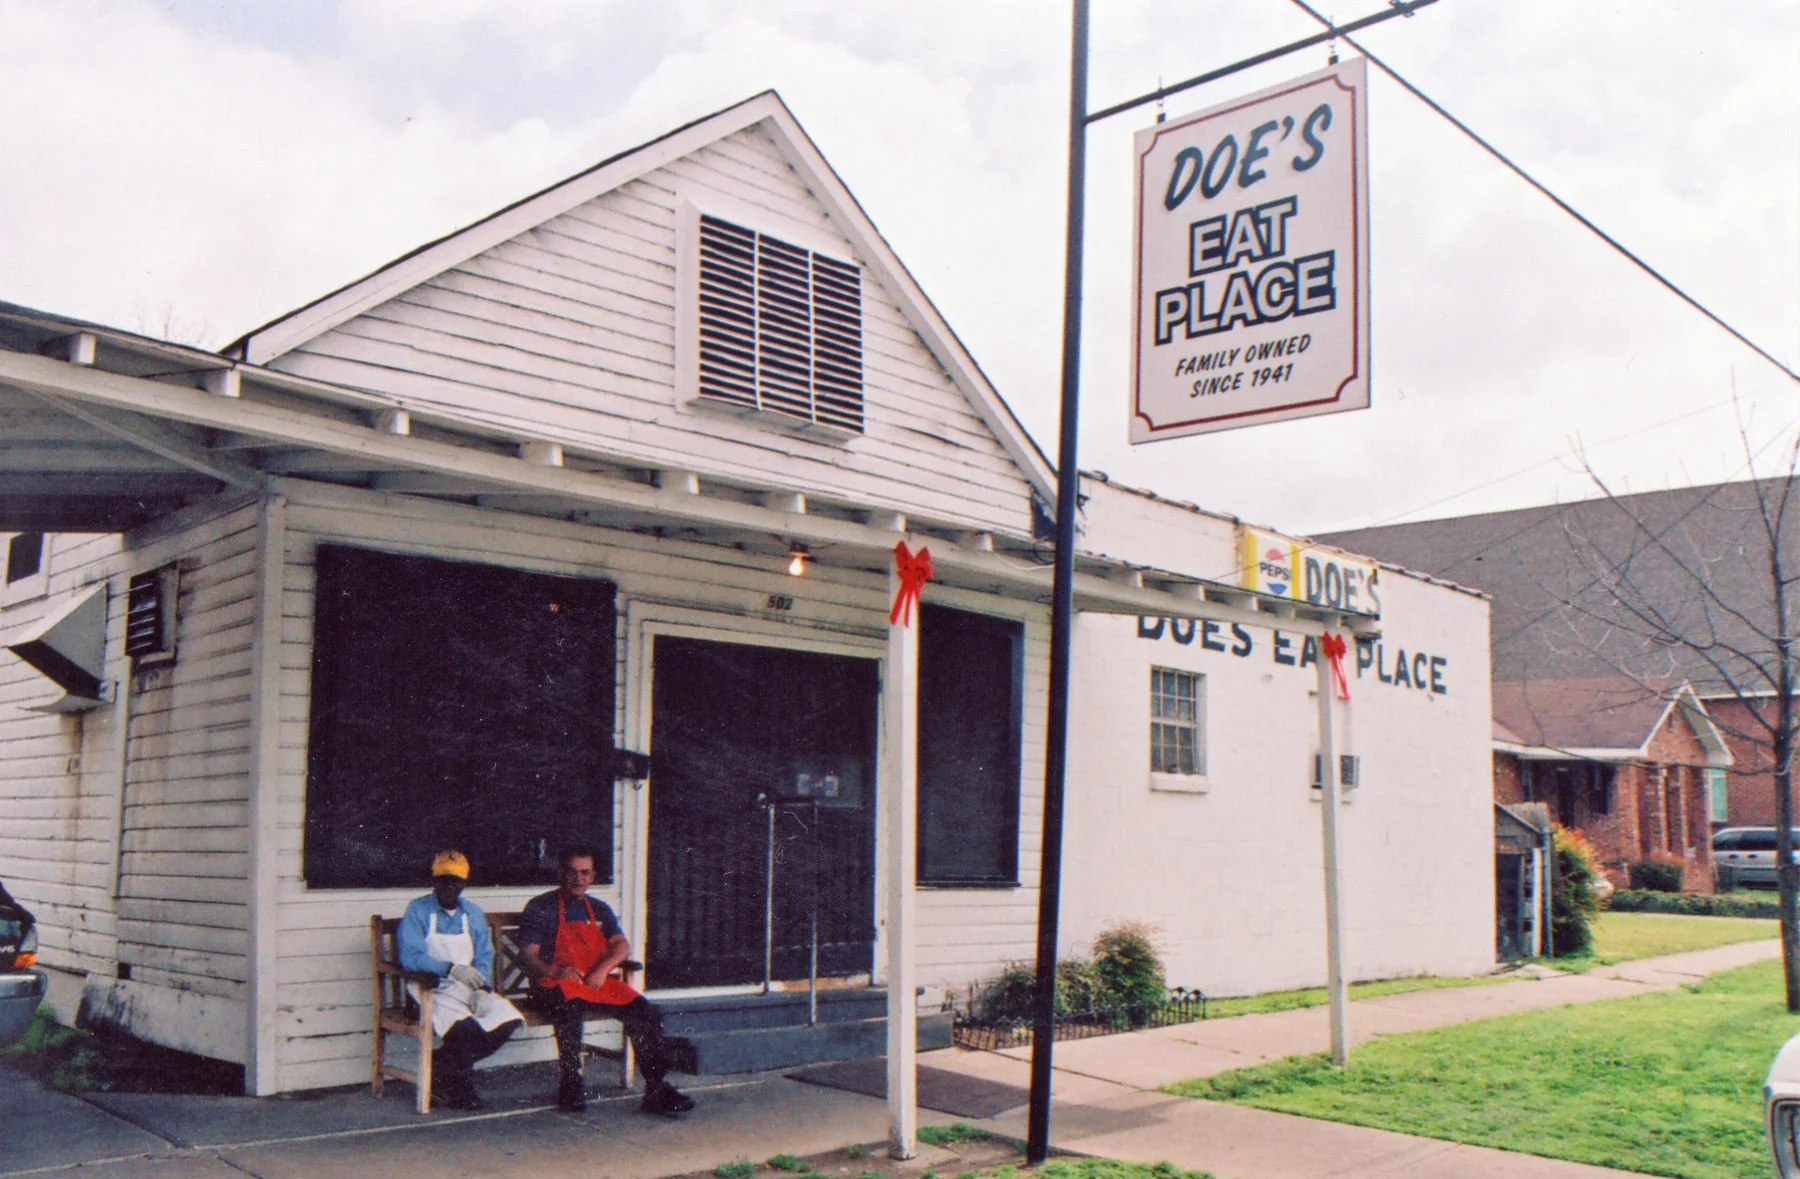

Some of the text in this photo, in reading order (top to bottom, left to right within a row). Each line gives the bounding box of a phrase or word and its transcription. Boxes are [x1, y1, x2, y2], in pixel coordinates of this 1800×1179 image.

[1164, 103, 1332, 211] DOE'S
[1189, 195, 1298, 277] EAT
[1154, 250, 1336, 345] PLACE
[1175, 333, 1311, 376] FAMILY OWNED
[1190, 363, 1294, 398] SINCE 1941
[1273, 629, 1318, 668] EA
[1355, 636, 1447, 694] PLACE
